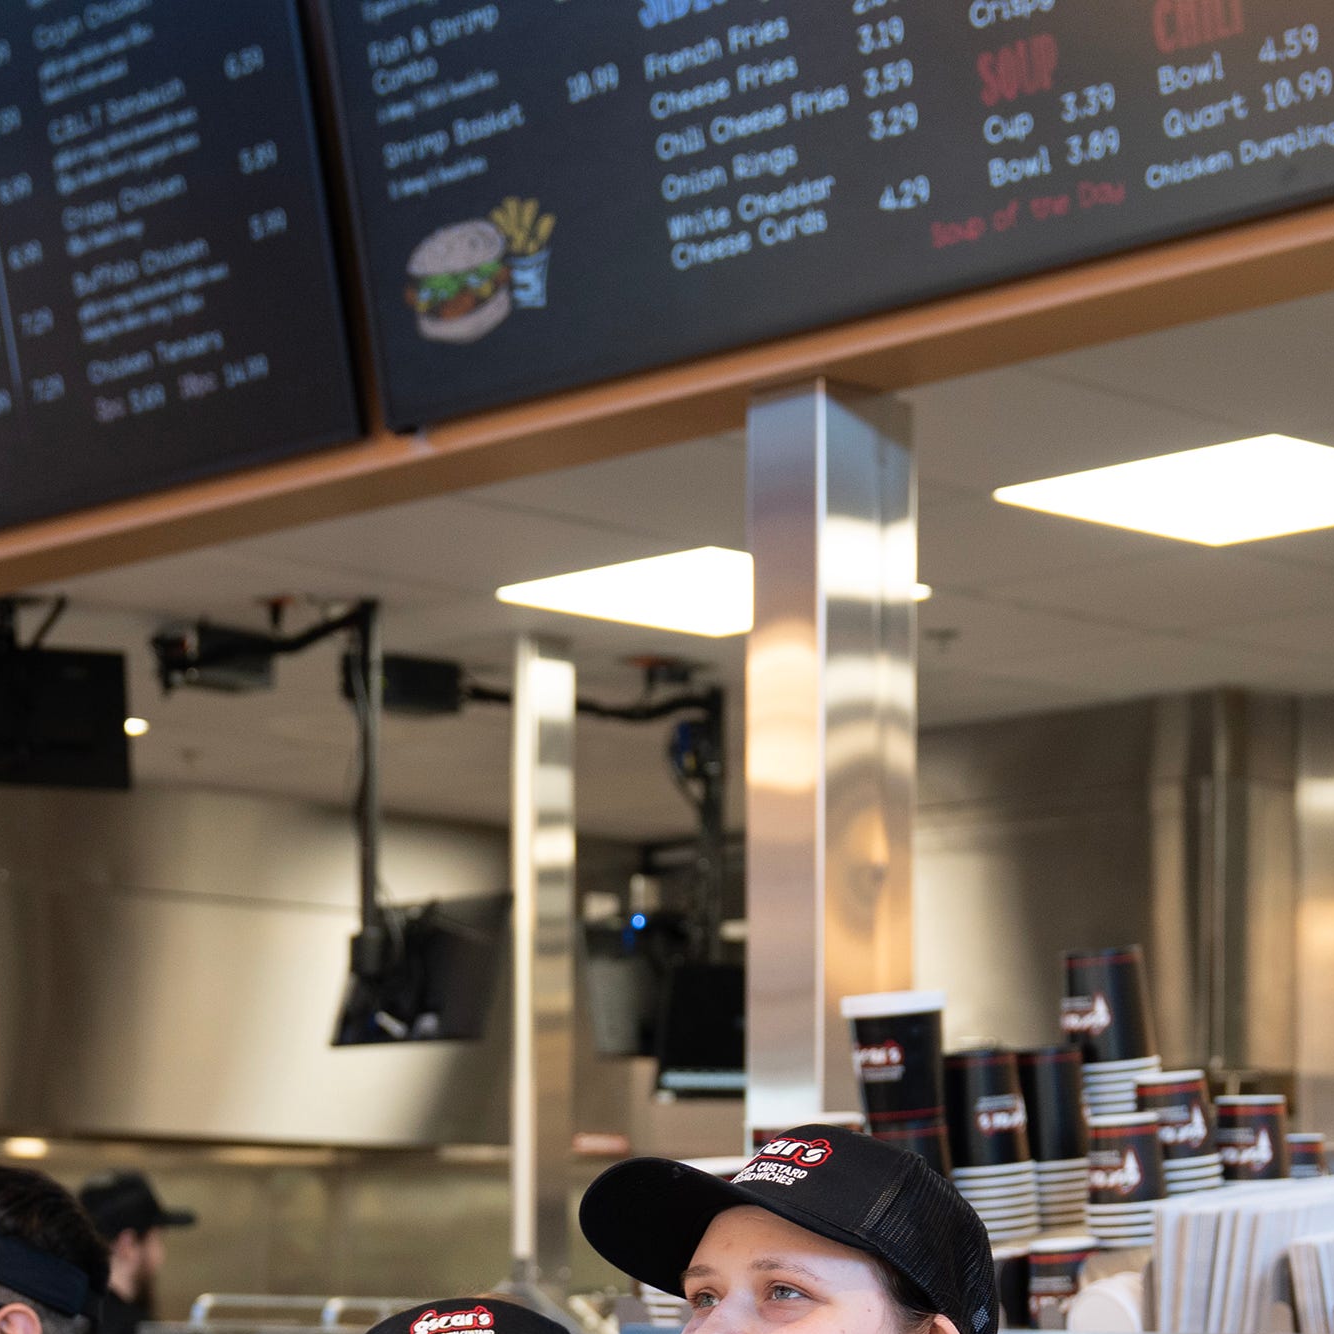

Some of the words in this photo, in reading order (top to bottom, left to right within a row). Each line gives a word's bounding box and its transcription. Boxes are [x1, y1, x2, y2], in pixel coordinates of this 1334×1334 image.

[430, 3, 500, 47] Shrimp
[643, 37, 723, 82] French
[727, 16, 790, 54] Fries
[856, 15, 906, 55] 3.19
[650, 75, 731, 120] Cheese
[736, 55, 800, 93] Fries
[862, 57, 914, 98] 3.59
[977, 31, 1059, 108] SOUP
[1157, 52, 1226, 95] Bowl
[1258, 24, 1320, 64] 4.59
[382, 130, 451, 170] Shrimp
[452, 101, 527, 147] Basket
[655, 122, 707, 160] Chili
[710, 102, 789, 145] Cheese
[791, 83, 851, 121] Fries
[868, 101, 919, 141] 3.29
[983, 111, 1035, 146] Cup
[1060, 82, 1116, 123] 3.39
[1163, 88, 1248, 140] Quart
[1263, 66, 1334, 114] 10.99
[661, 165, 728, 202] Onion
[731, 144, 800, 182] Rings
[987, 144, 1053, 189] Bowl
[1066, 125, 1122, 167] 3.89
[1144, 149, 1234, 190] Chicken
[667, 204, 733, 242] White
[736, 173, 837, 223] Cheddar
[670, 230, 753, 271] Cheese
[757, 208, 829, 248] Curds
[878, 174, 931, 212] 4.29
[757, 1161, 808, 1180] CUSTARD
